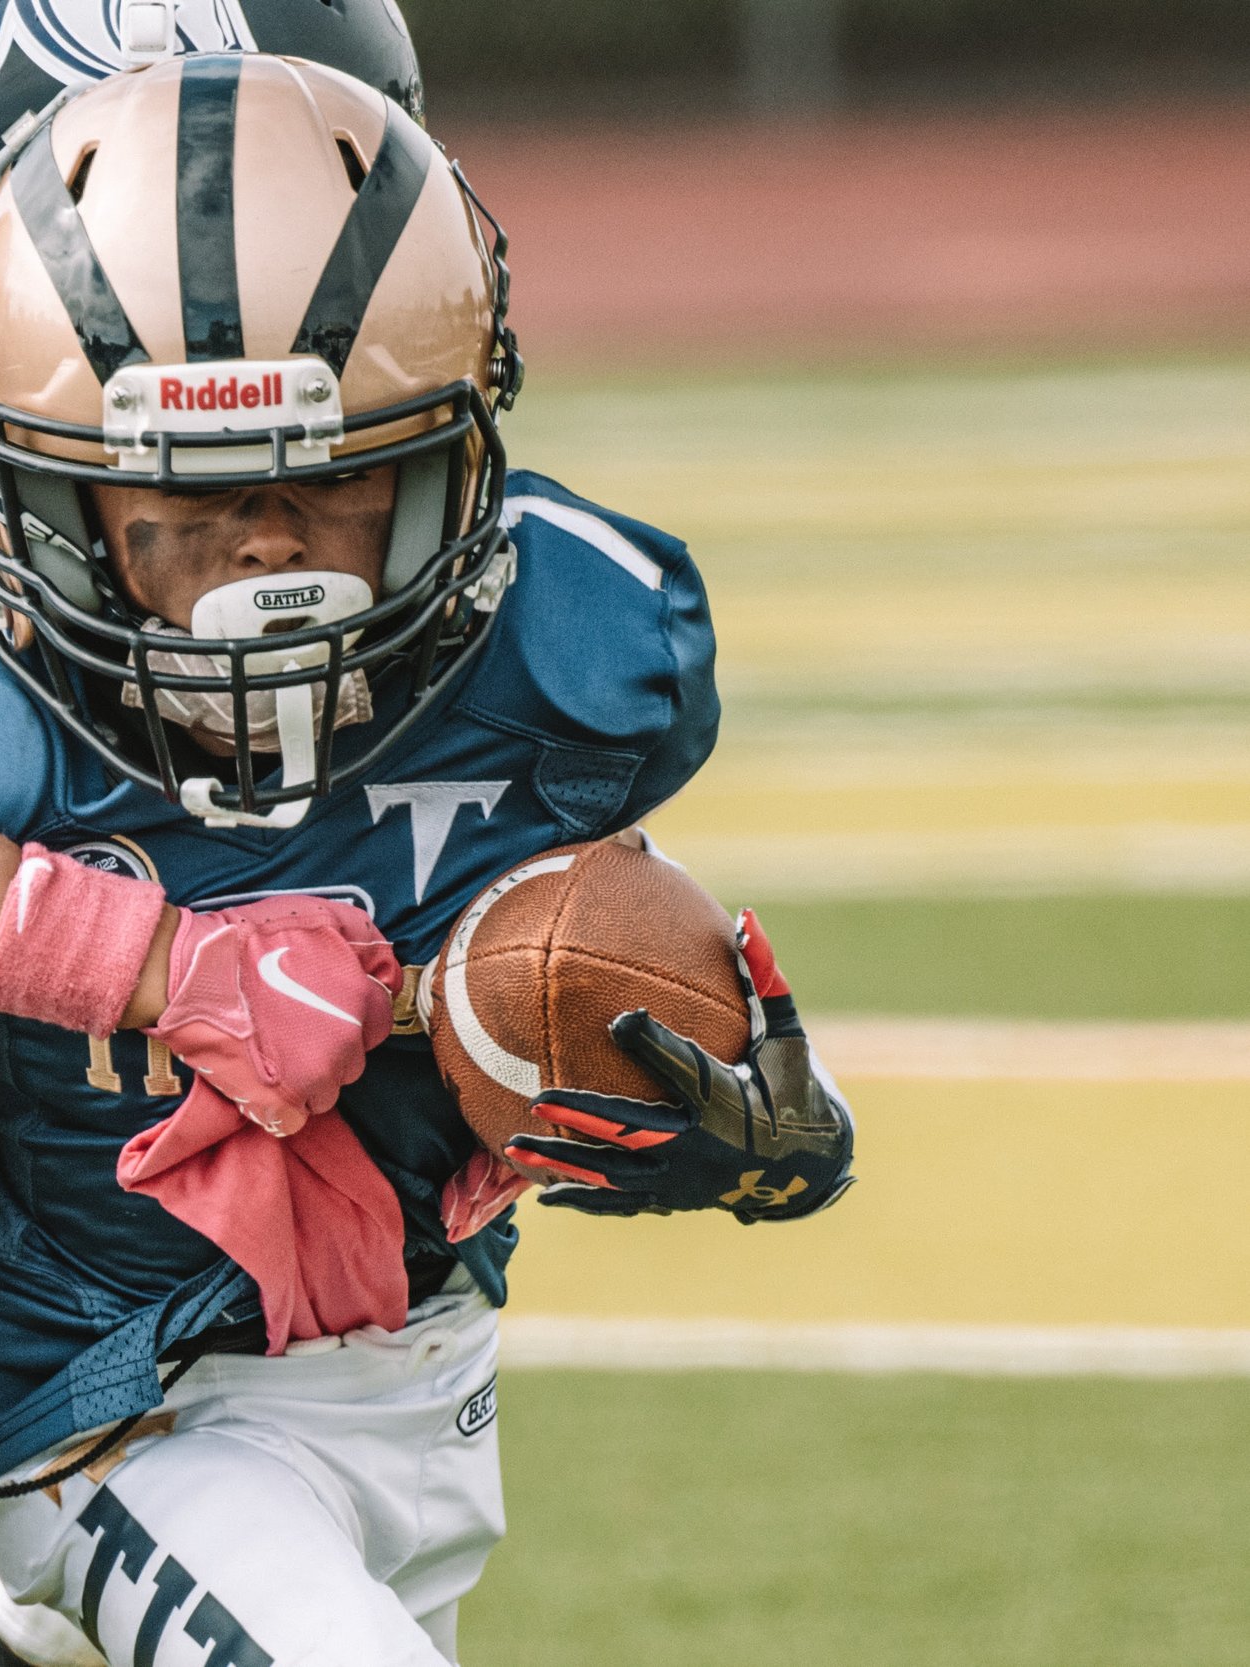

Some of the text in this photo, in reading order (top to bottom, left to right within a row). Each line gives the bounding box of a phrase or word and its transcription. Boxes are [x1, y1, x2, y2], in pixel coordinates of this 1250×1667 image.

[160, 372, 283, 411] Riddell
[261, 590, 318, 607] BATTLE
[363, 780, 512, 907] T
[88, 856, 119, 871] 022
